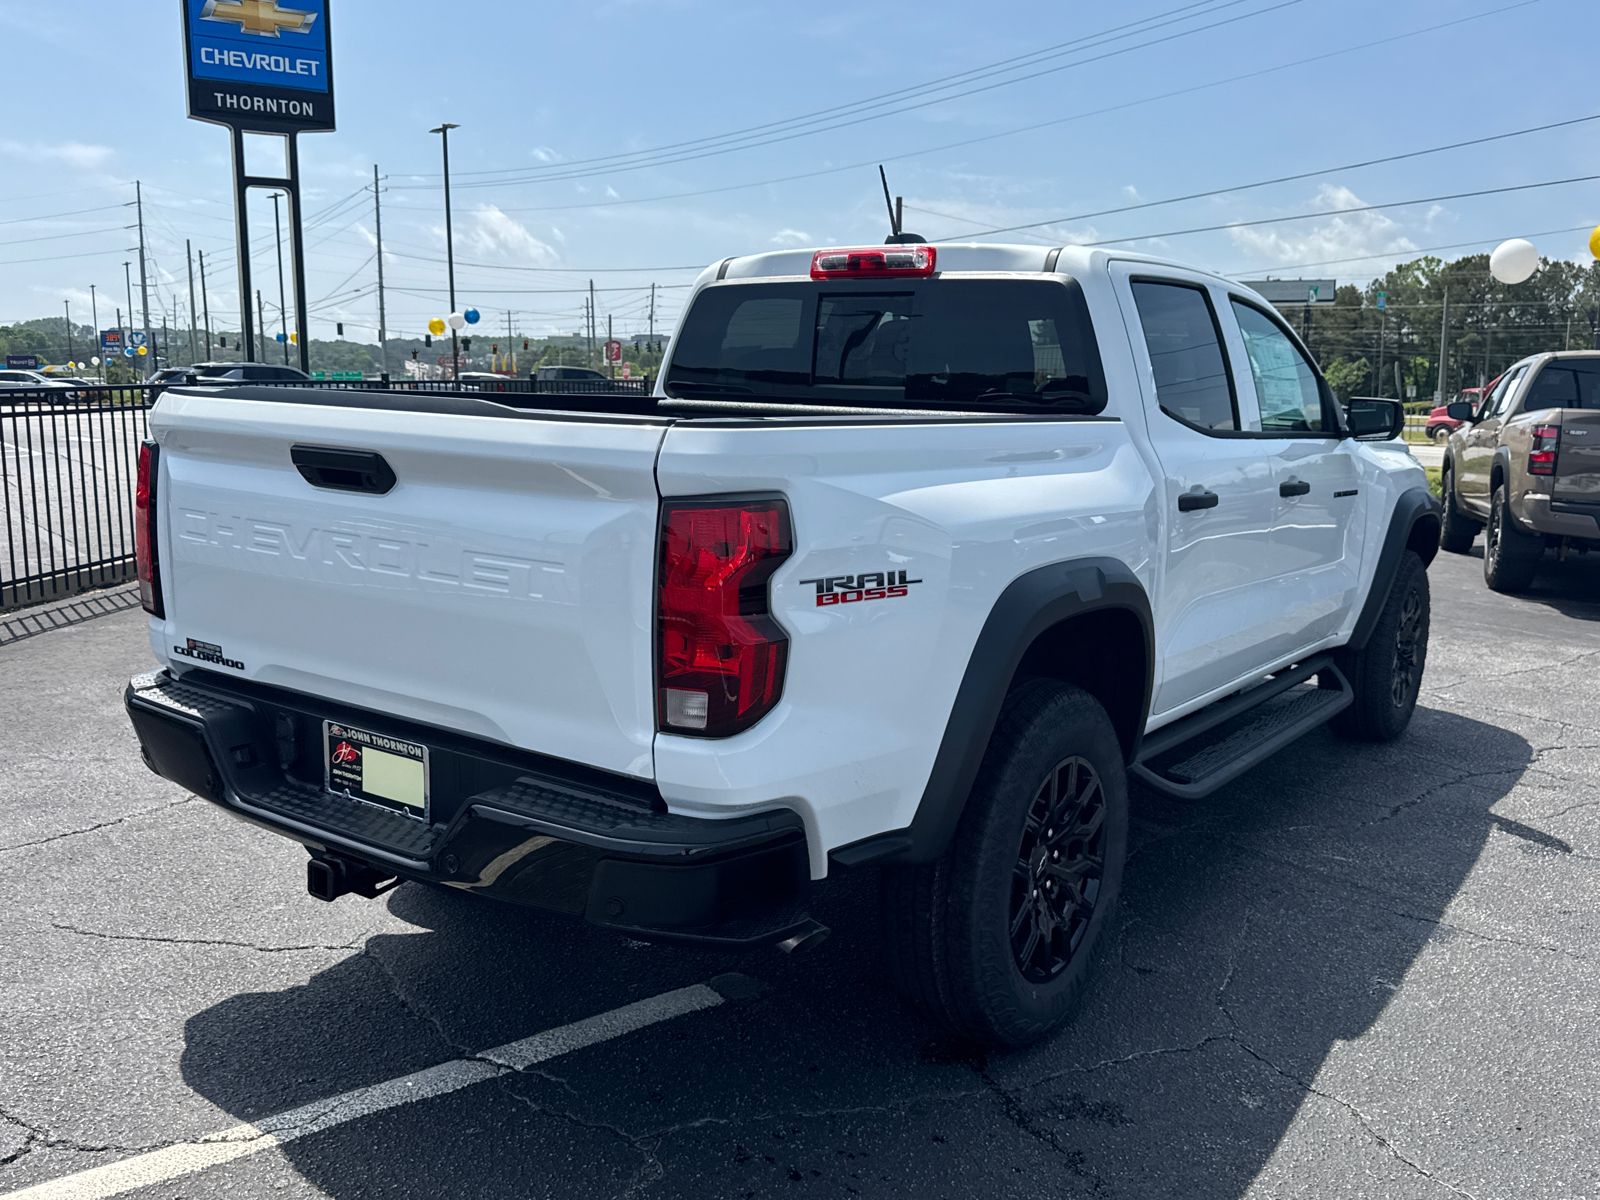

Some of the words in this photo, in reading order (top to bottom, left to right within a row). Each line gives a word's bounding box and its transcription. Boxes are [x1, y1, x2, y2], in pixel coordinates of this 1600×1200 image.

[200, 47, 320, 76] CHEVROLET
[213, 92, 314, 116] THORNTON
[178, 506, 565, 598] CHEVROLET
[799, 569, 923, 594] TRAIL
[815, 584, 908, 607] BOSS
[173, 645, 245, 670] COLORADO
[347, 729, 370, 743] JOHN
[371, 735, 422, 757] THORNTON
